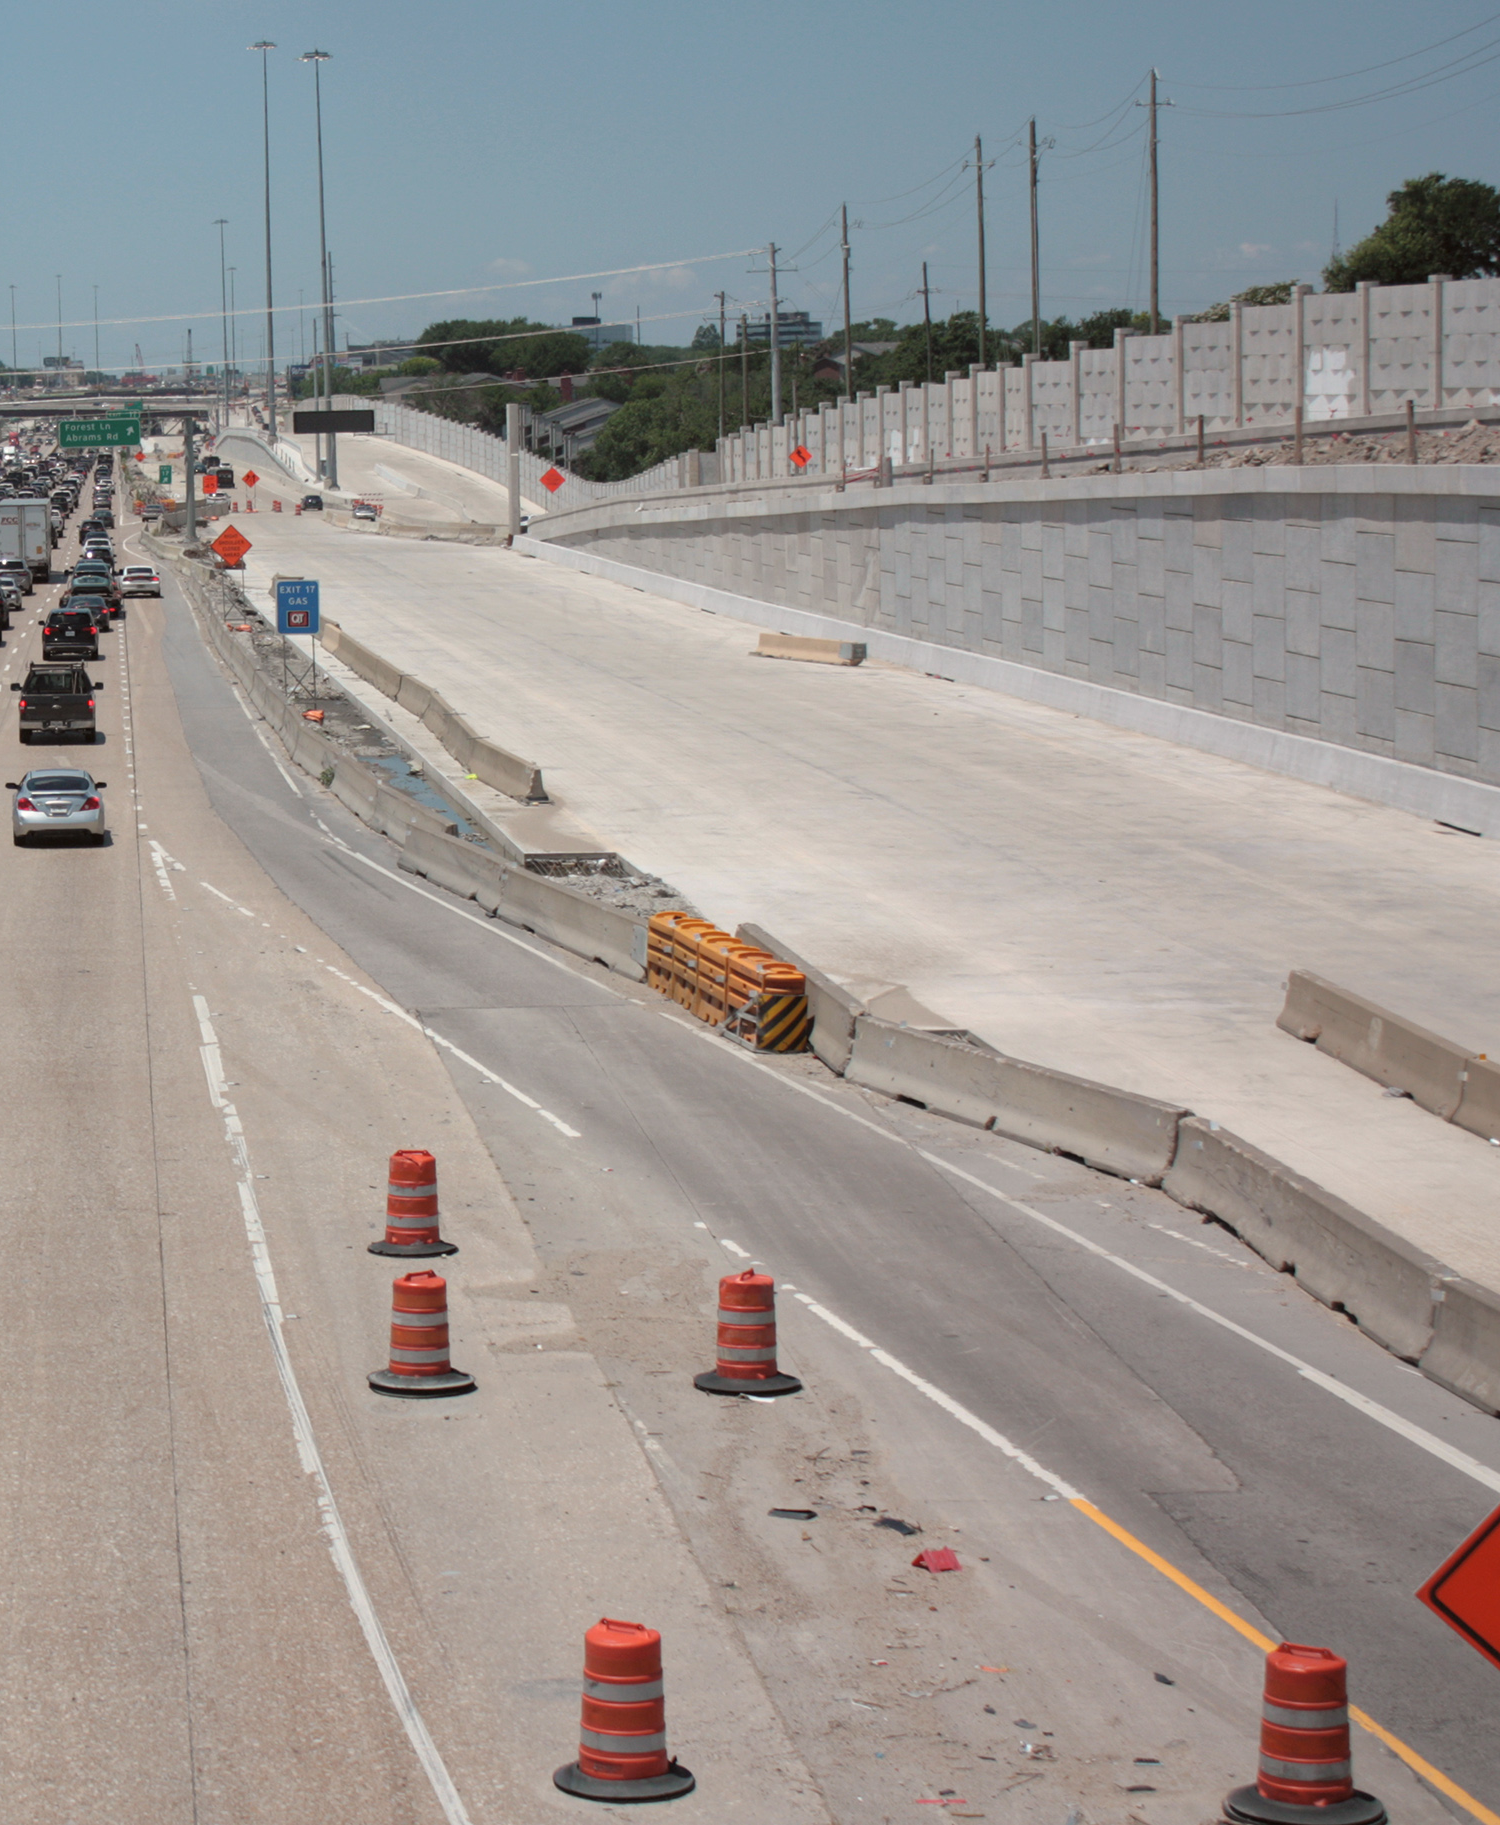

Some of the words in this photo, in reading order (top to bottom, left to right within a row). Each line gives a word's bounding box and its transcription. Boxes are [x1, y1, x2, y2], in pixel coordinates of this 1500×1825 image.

[64, 423, 95, 432] Forest
[99, 422, 111, 430] Ln
[65, 433, 102, 442] Abrams
[106, 432, 119, 441] Rd
[279, 585, 302, 594] EXIT
[305, 585, 316, 593] 17
[288, 596, 308, 605] GAS
[291, 613, 305, 624] QT
